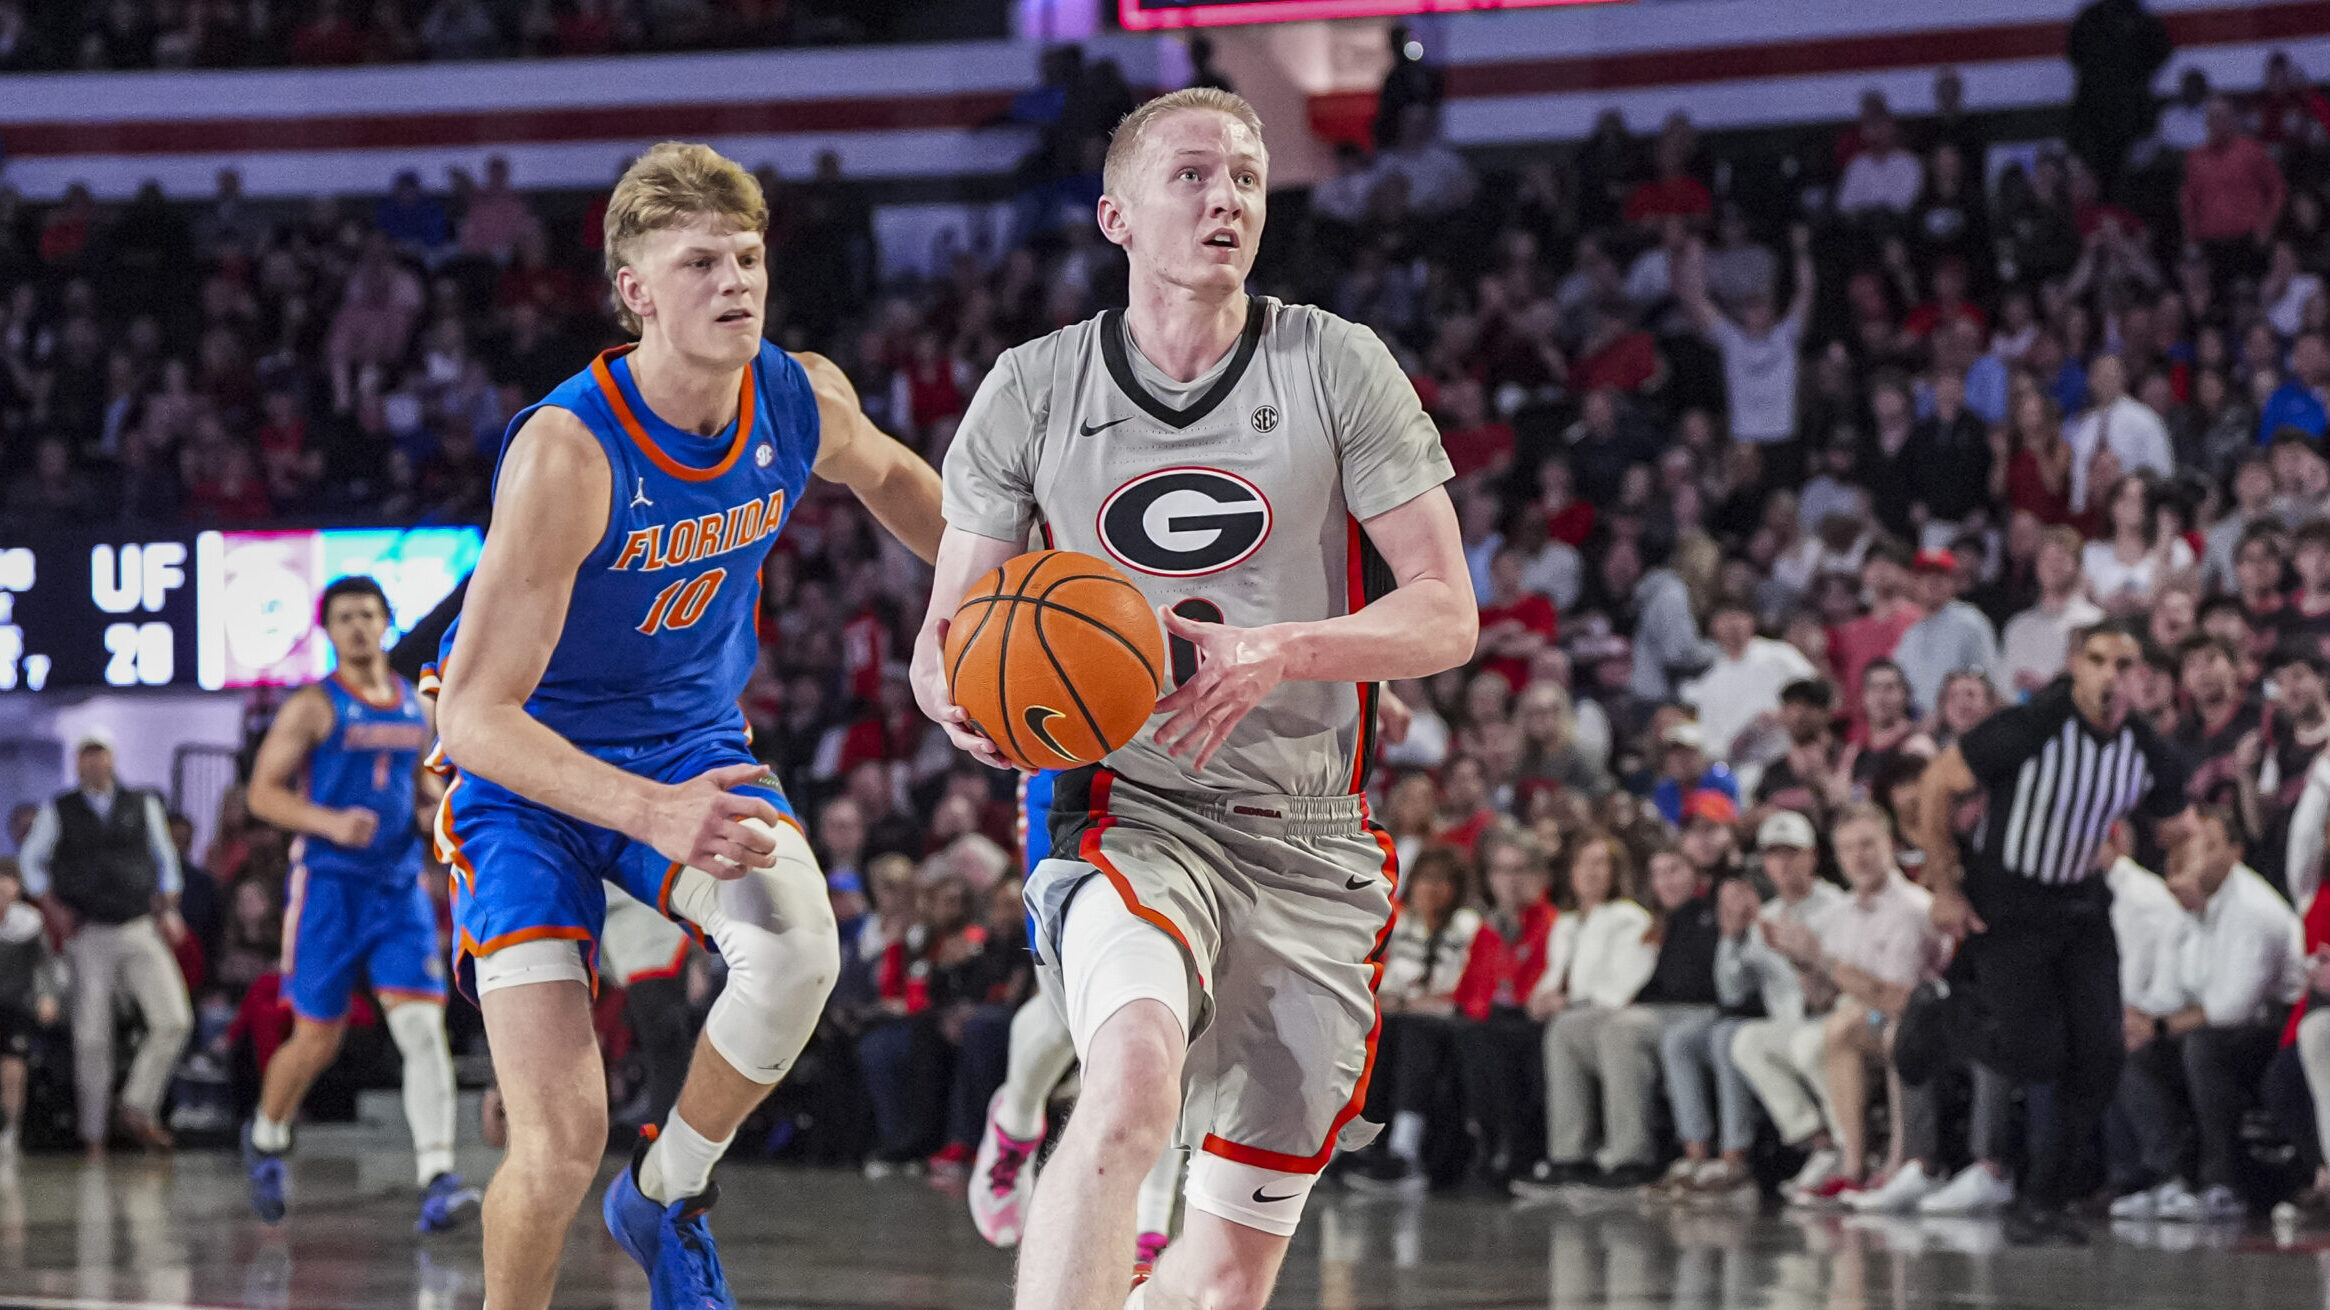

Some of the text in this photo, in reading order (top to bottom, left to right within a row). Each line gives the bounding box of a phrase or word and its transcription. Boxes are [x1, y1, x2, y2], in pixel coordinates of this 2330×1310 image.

[1253, 407, 1277, 431] SEC
[608, 488, 785, 571] FLORIDA
[1102, 472, 1266, 572] G
[91, 541, 188, 613] UF
[635, 567, 728, 636] 10
[1233, 805, 1283, 819] GEORGIA
